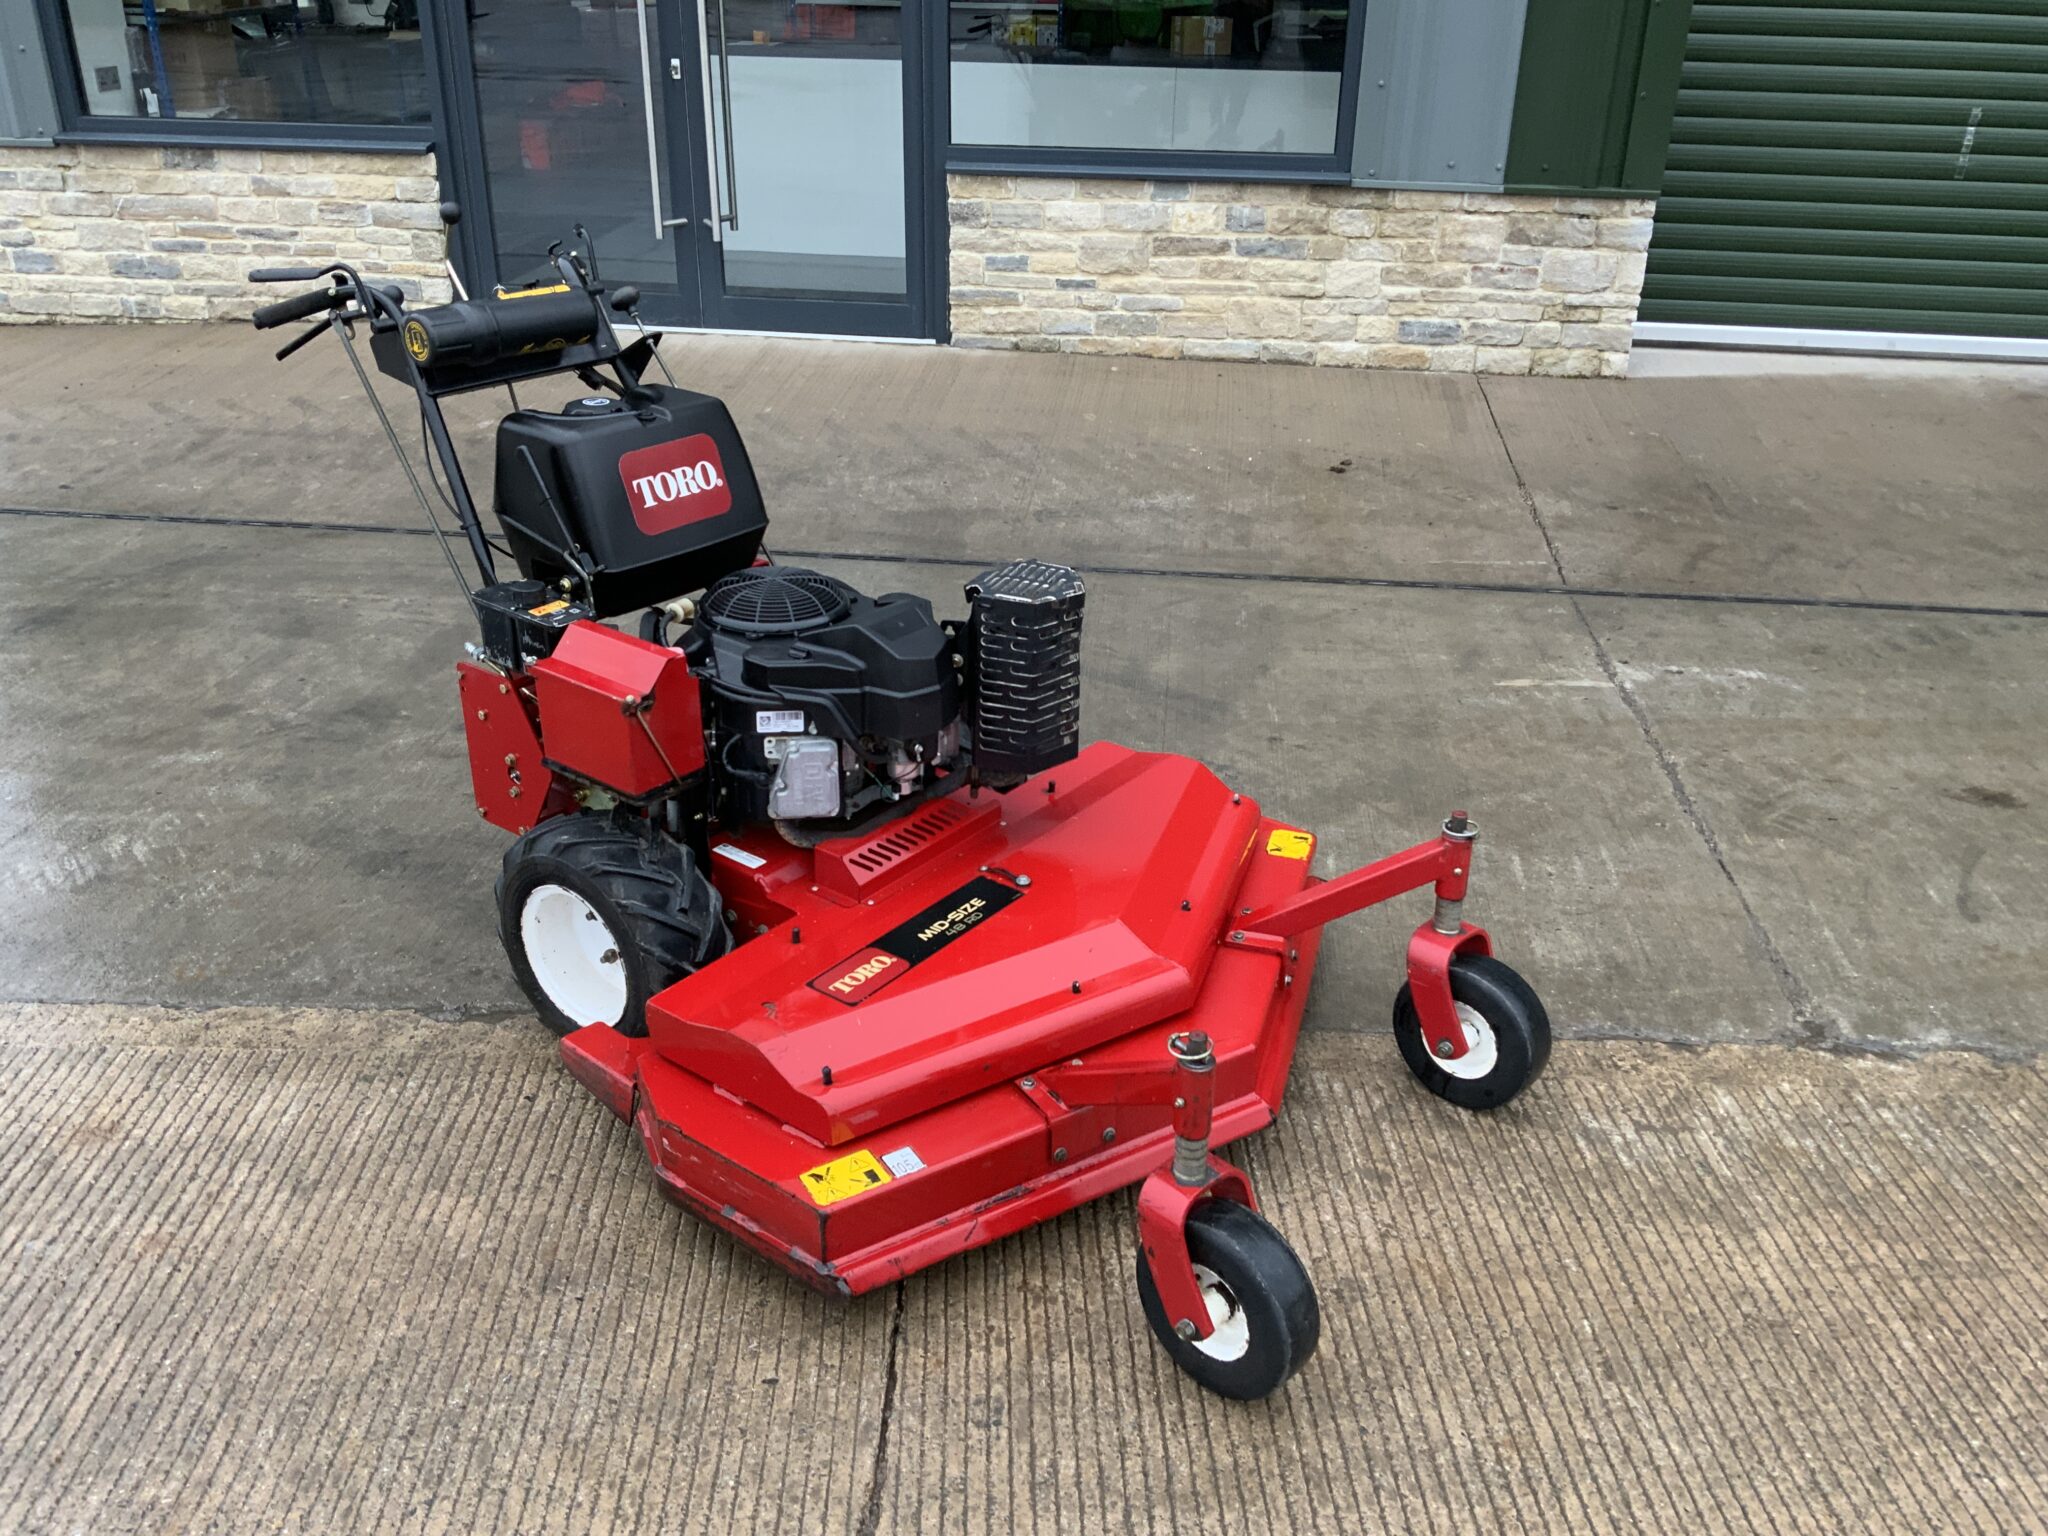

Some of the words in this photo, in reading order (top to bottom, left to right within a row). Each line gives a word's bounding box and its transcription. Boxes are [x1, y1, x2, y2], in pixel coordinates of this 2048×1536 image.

[632, 460, 718, 508] TORO
[917, 897, 986, 941] MID-SIZE
[945, 923, 966, 936] 48
[828, 955, 893, 994] TORO
[891, 1159, 915, 1175] 105
